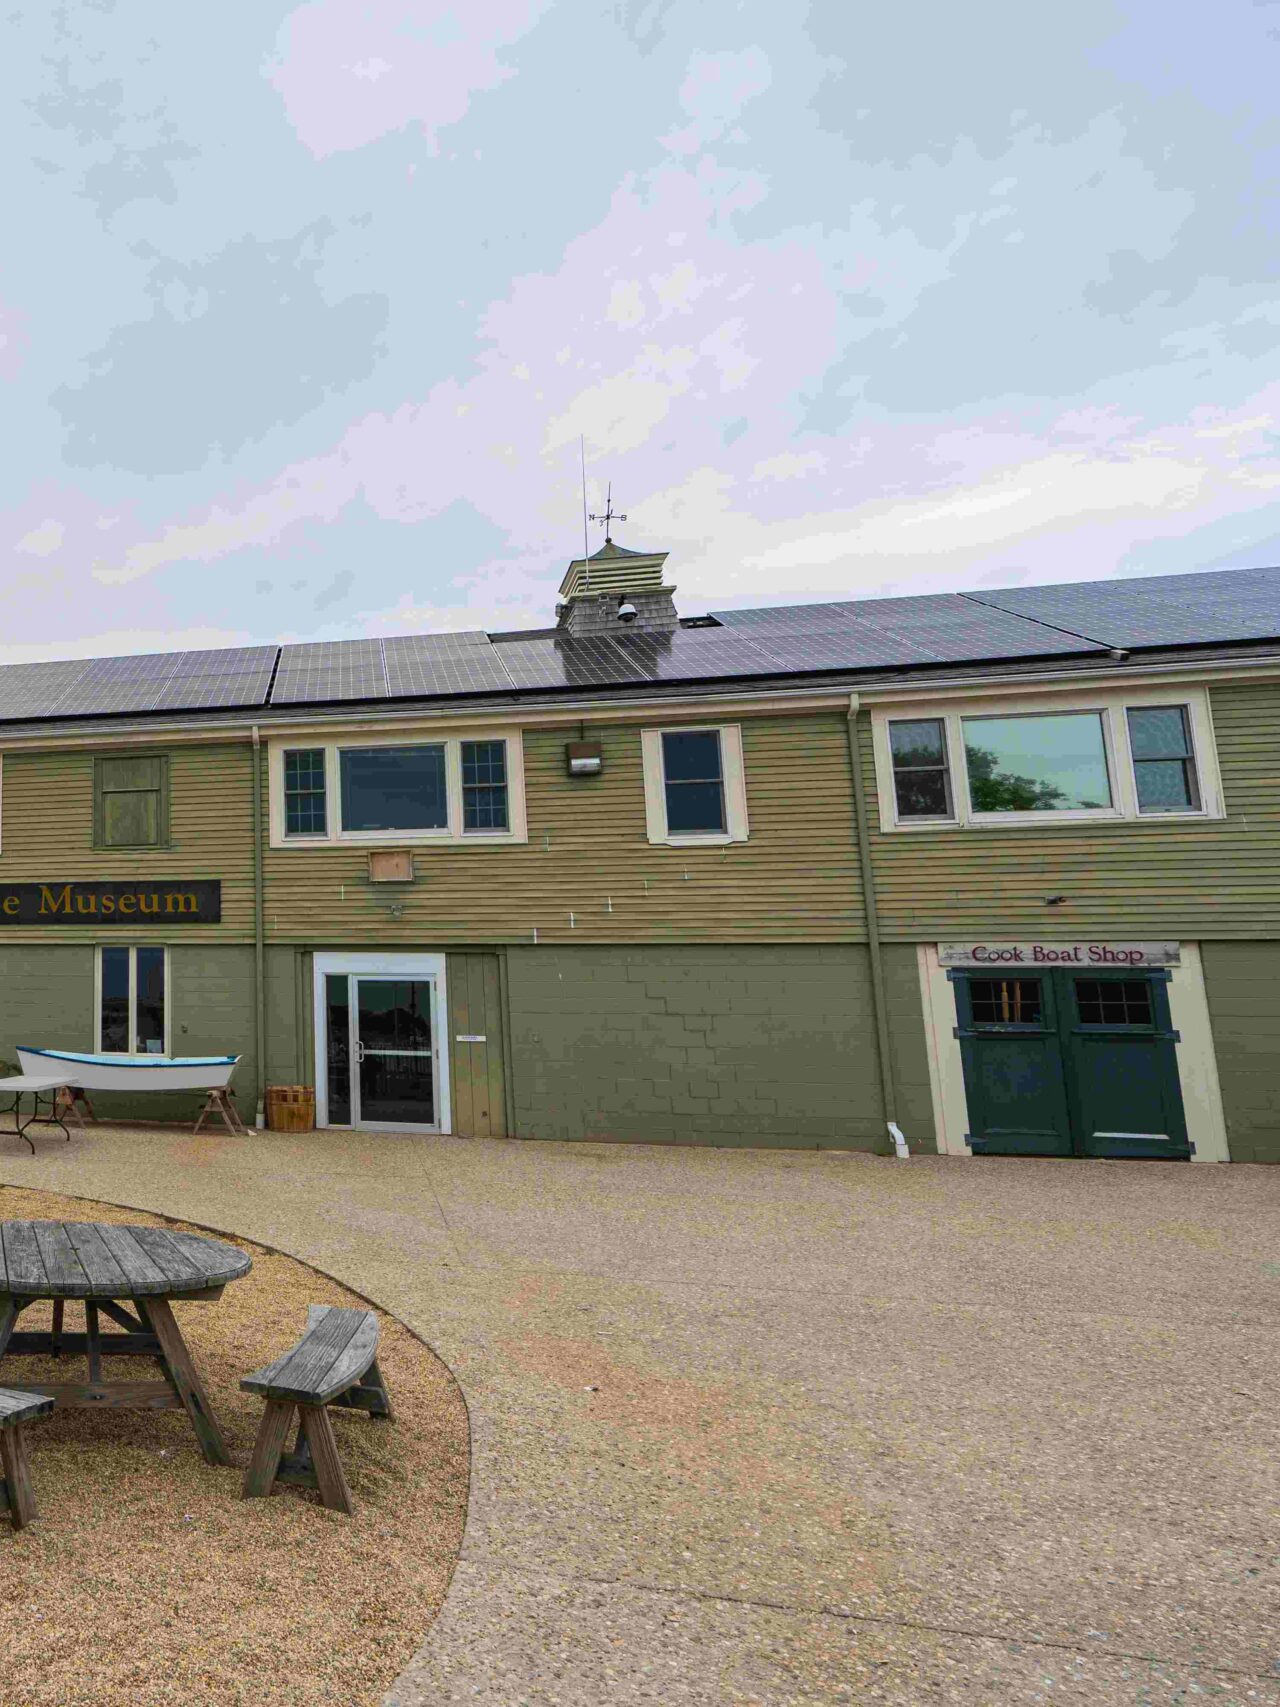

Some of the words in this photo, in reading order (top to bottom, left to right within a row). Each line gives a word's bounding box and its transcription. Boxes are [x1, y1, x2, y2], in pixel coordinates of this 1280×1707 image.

[37, 884, 200, 914] Museum
[971, 945, 1024, 962] Cook
[1032, 945, 1082, 962] Boat
[1088, 945, 1144, 966] Shop
